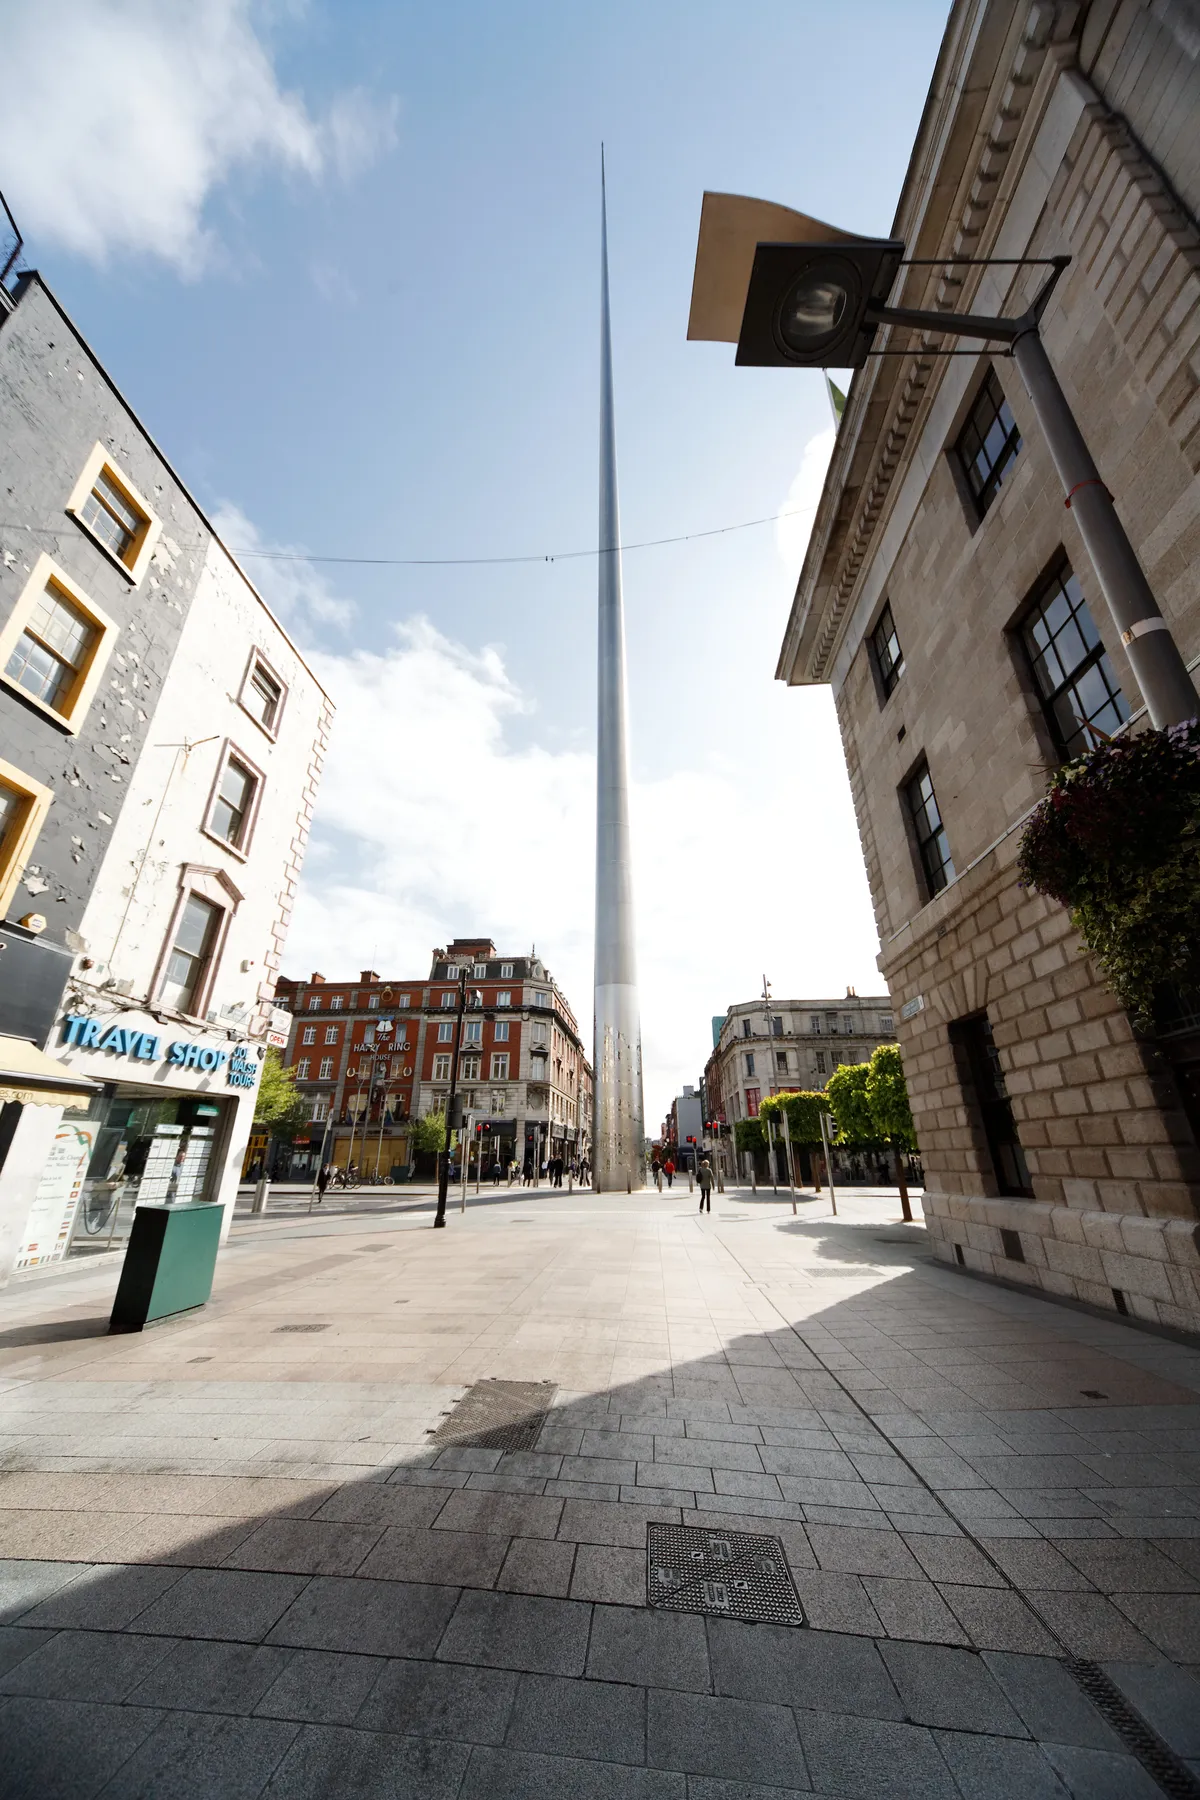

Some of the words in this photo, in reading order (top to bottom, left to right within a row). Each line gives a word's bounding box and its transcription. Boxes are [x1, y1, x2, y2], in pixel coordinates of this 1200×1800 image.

[269, 1034, 285, 1045] OPEN
[377, 1033, 390, 1041] The
[65, 1015, 161, 1060] TRAVEL
[169, 1041, 229, 1071] SHOP
[388, 1042, 411, 1051] RING
[369, 1053, 392, 1061] HOUSE
[230, 1059, 257, 1073] WALSH
[228, 1072, 256, 1086] TOURS
